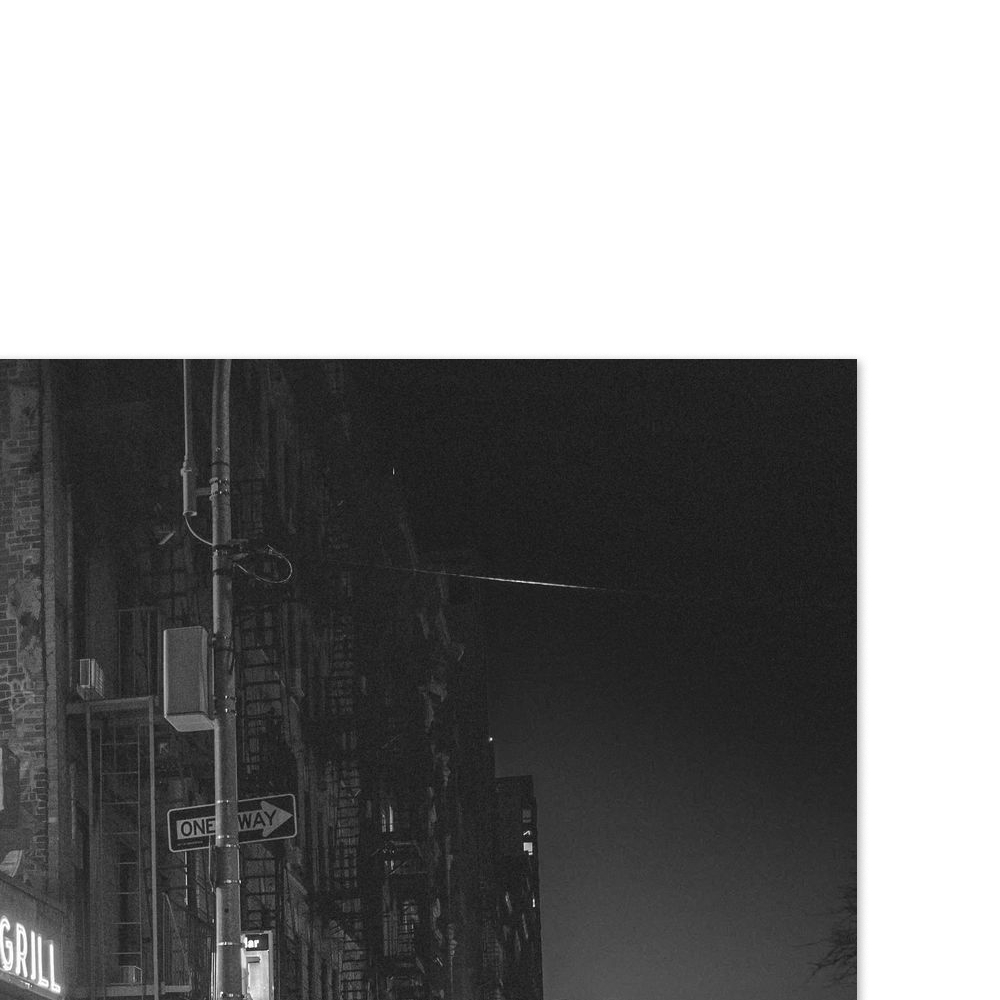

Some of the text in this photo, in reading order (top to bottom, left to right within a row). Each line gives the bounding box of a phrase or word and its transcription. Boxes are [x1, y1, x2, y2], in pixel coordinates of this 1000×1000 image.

[181, 809, 277, 837] ONE WAY
[0, 914, 62, 994] GRILL
